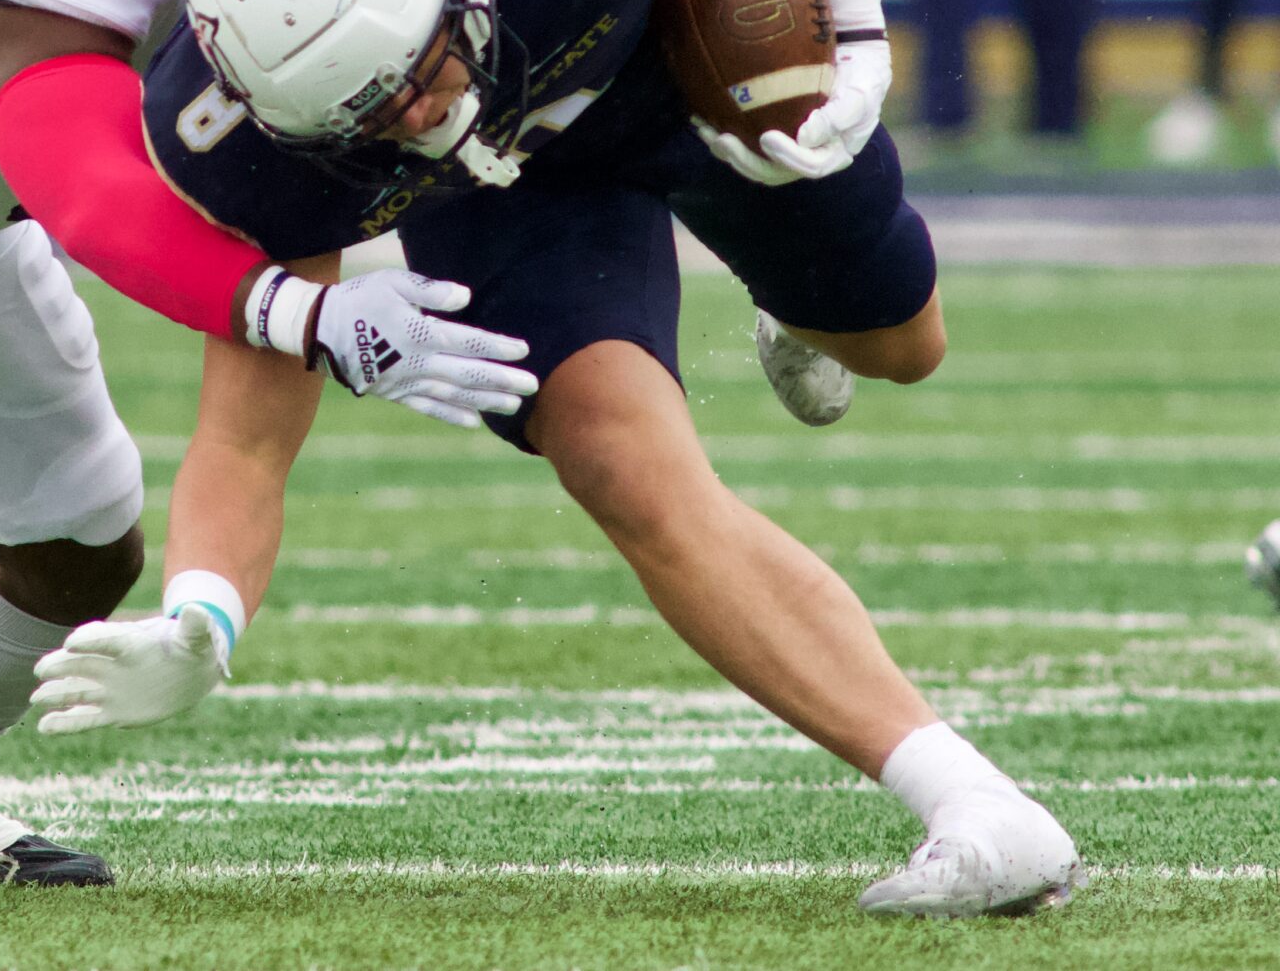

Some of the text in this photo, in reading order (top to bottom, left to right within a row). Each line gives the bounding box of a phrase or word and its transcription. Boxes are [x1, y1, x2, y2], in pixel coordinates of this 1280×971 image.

[176, 80, 248, 153] 8
[351, 84, 380, 109] 406
[354, 319, 376, 385] adidas
